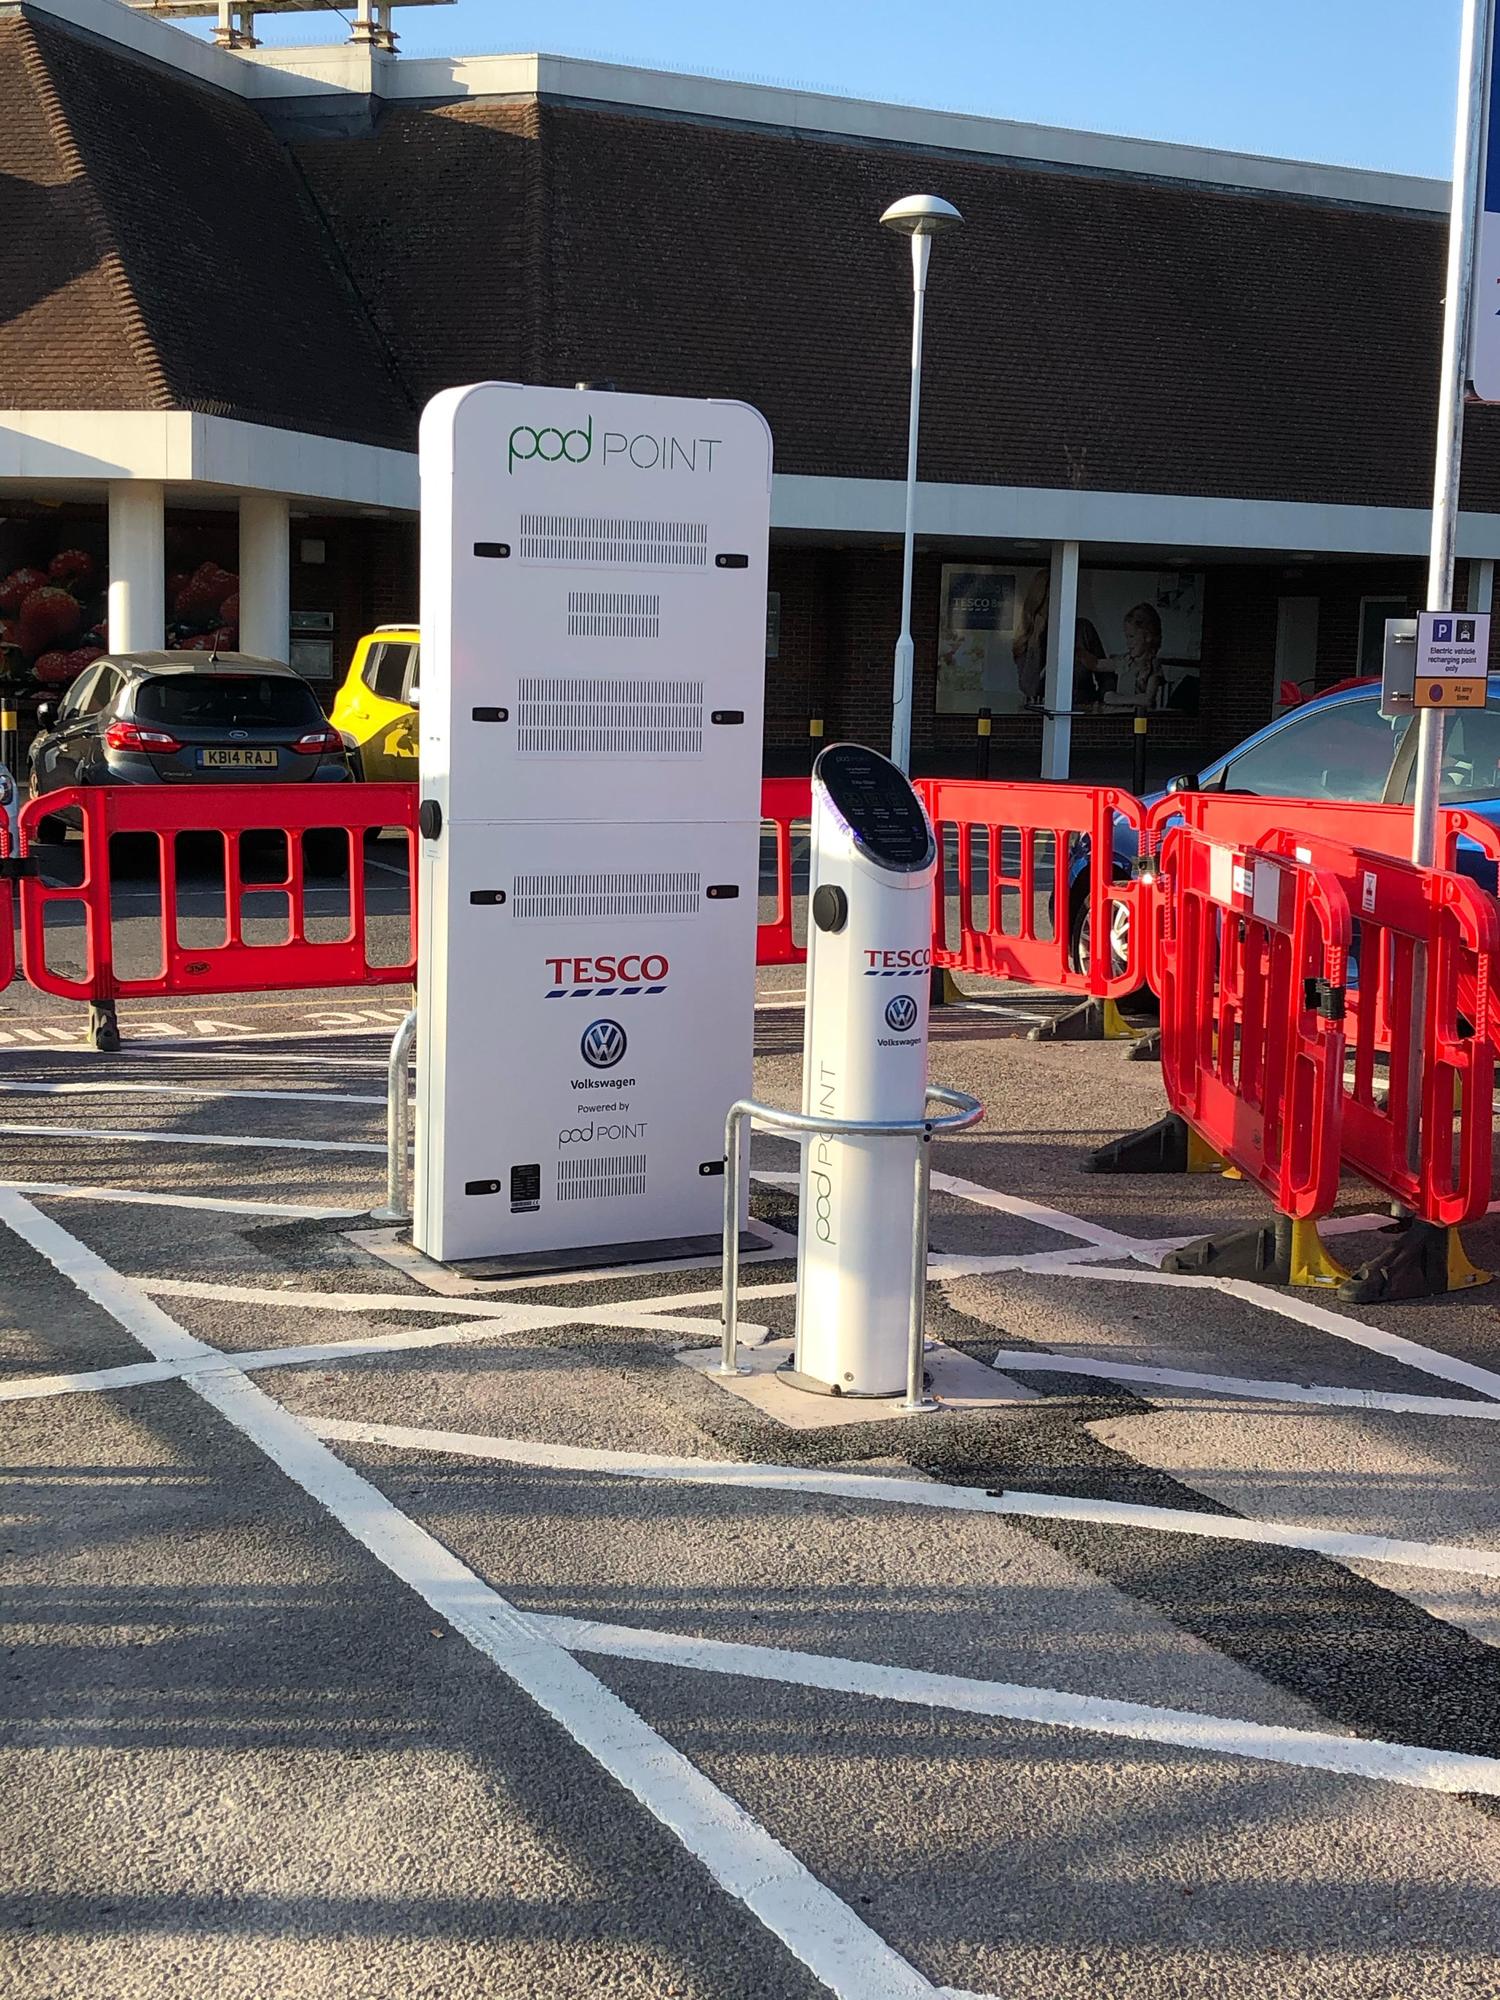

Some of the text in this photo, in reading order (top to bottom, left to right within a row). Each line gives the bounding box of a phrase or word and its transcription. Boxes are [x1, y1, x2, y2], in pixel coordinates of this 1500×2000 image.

[508, 414, 722, 475] pod POINT
[953, 598, 990, 608] TESCO
[1438, 624, 1448, 638] P
[1430, 647, 1476, 655] Electric vehicle
[1428, 656, 1477, 665] recharging point
[1445, 665, 1459, 674] only
[208, 751, 273, 764] KB14 RAJ
[863, 949, 931, 968] TESCO
[545, 954, 669, 984] TESCO
[877, 1037, 921, 1047] Volkswagen
[570, 1076, 636, 1091] Volkswagen
[577, 1101, 630, 1113] Powered by
[558, 1120, 648, 1150] pod POINT
[811, 1170, 837, 1245] pod
